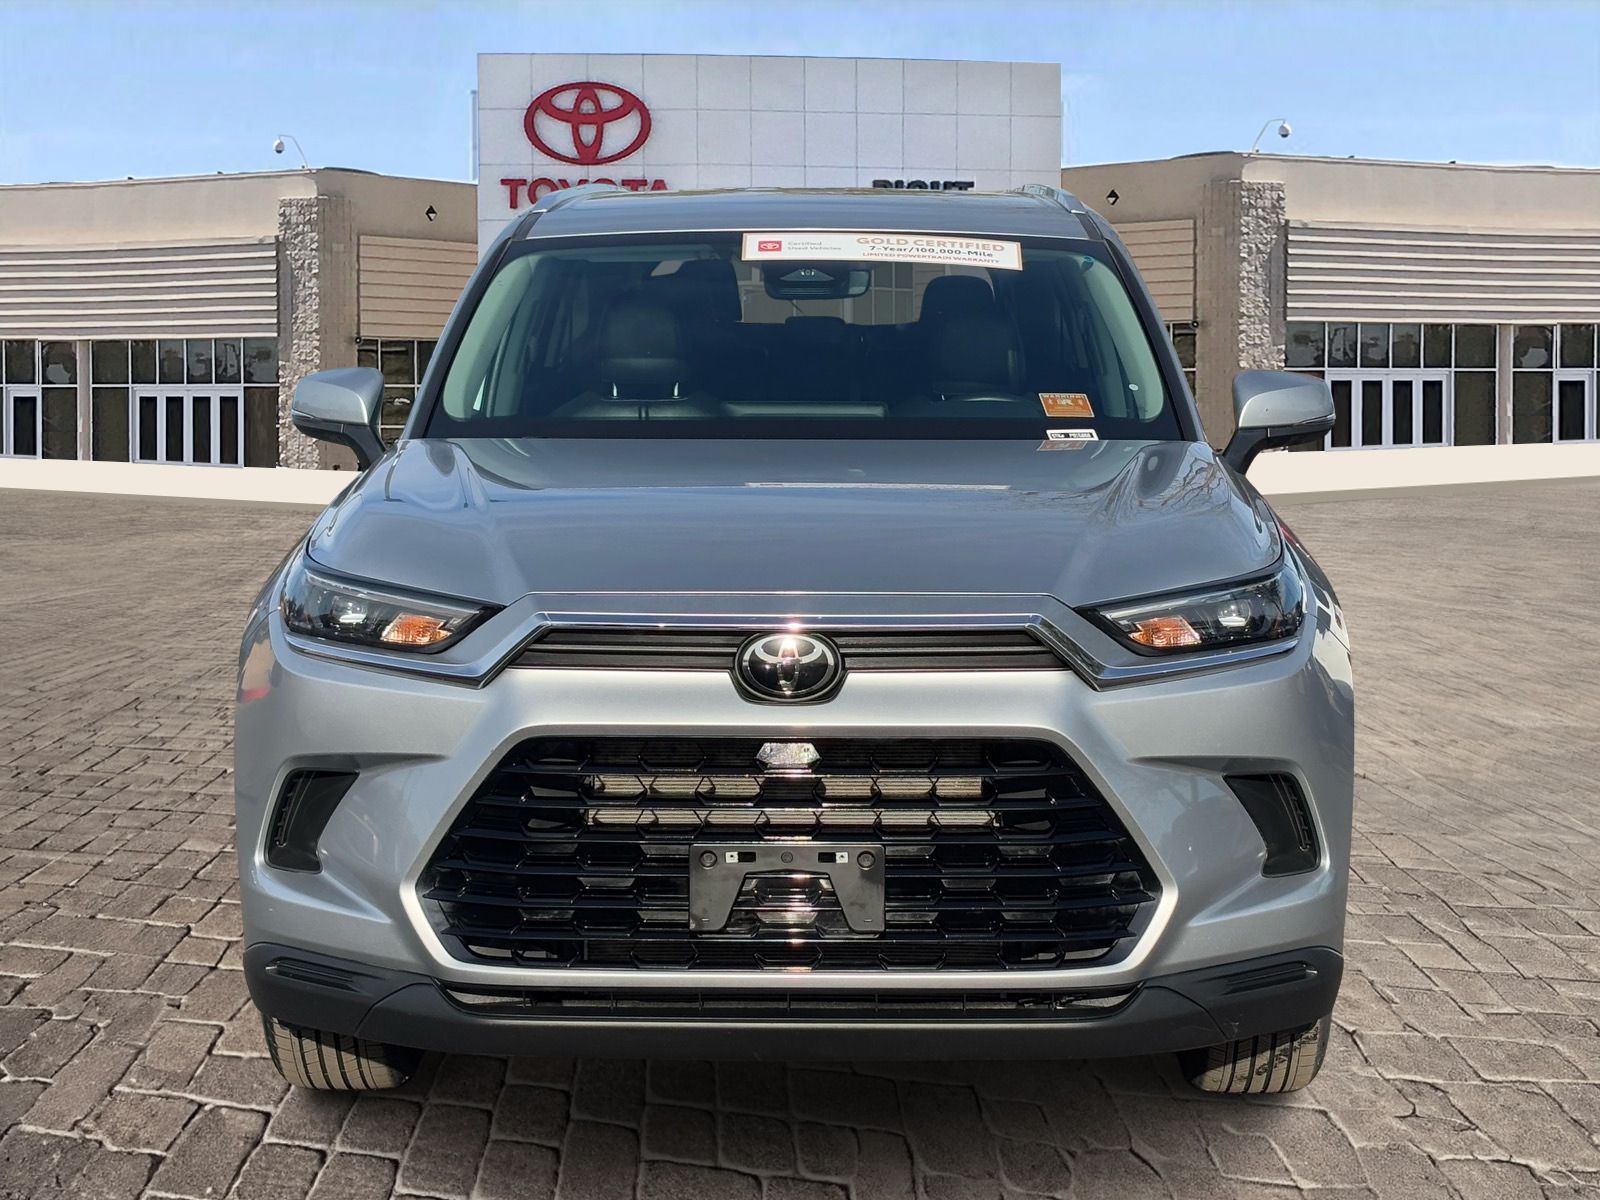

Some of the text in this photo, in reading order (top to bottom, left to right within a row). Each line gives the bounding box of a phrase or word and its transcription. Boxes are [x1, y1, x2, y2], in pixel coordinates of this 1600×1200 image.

[857, 237, 1004, 252] GOLD CERTIFIED
[869, 245, 993, 258] 7-Year/100,000-Mile
[953, 256, 1000, 264] WARRANTY
